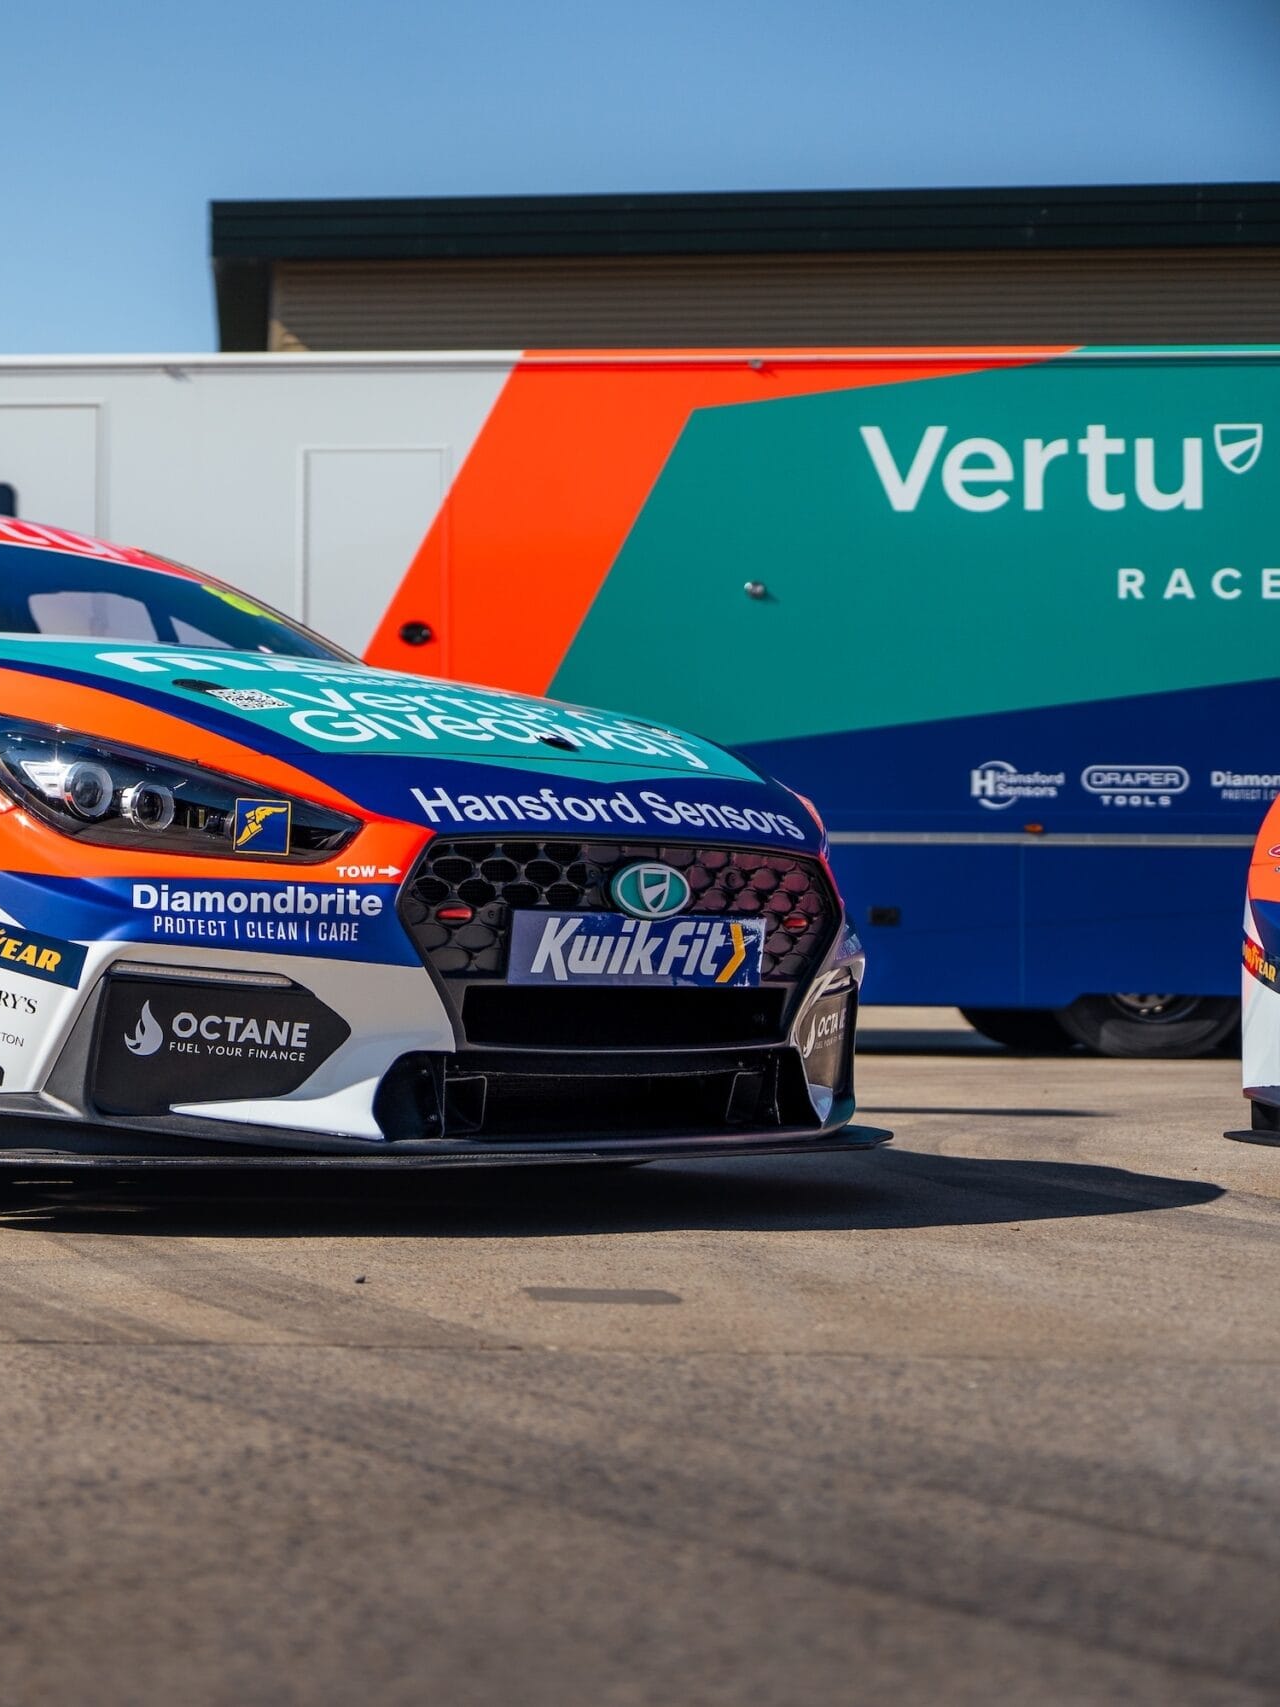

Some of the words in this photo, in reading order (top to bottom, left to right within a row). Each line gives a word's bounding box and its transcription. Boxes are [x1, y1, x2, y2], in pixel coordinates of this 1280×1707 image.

[859, 423, 1204, 512] Vertu
[269, 688, 553, 723] Vertu
[996, 771, 1065, 786] Hansford
[1090, 772, 1181, 786] DRAPER
[997, 784, 1058, 798] Sensors
[1099, 795, 1172, 807] TOOLS
[410, 786, 643, 825] Hansford
[638, 791, 806, 841] Sensors
[336, 865, 377, 879] TOW
[132, 884, 383, 917] Diamondbrite
[153, 915, 228, 937] PROTECT
[246, 921, 298, 941] CLEAN
[318, 921, 360, 942] CARE
[172, 1011, 310, 1048] OCTANE
[169, 1041, 201, 1054] FUEL
[206, 1045, 243, 1058] YOUR
[248, 1048, 306, 1063] FINANCE
